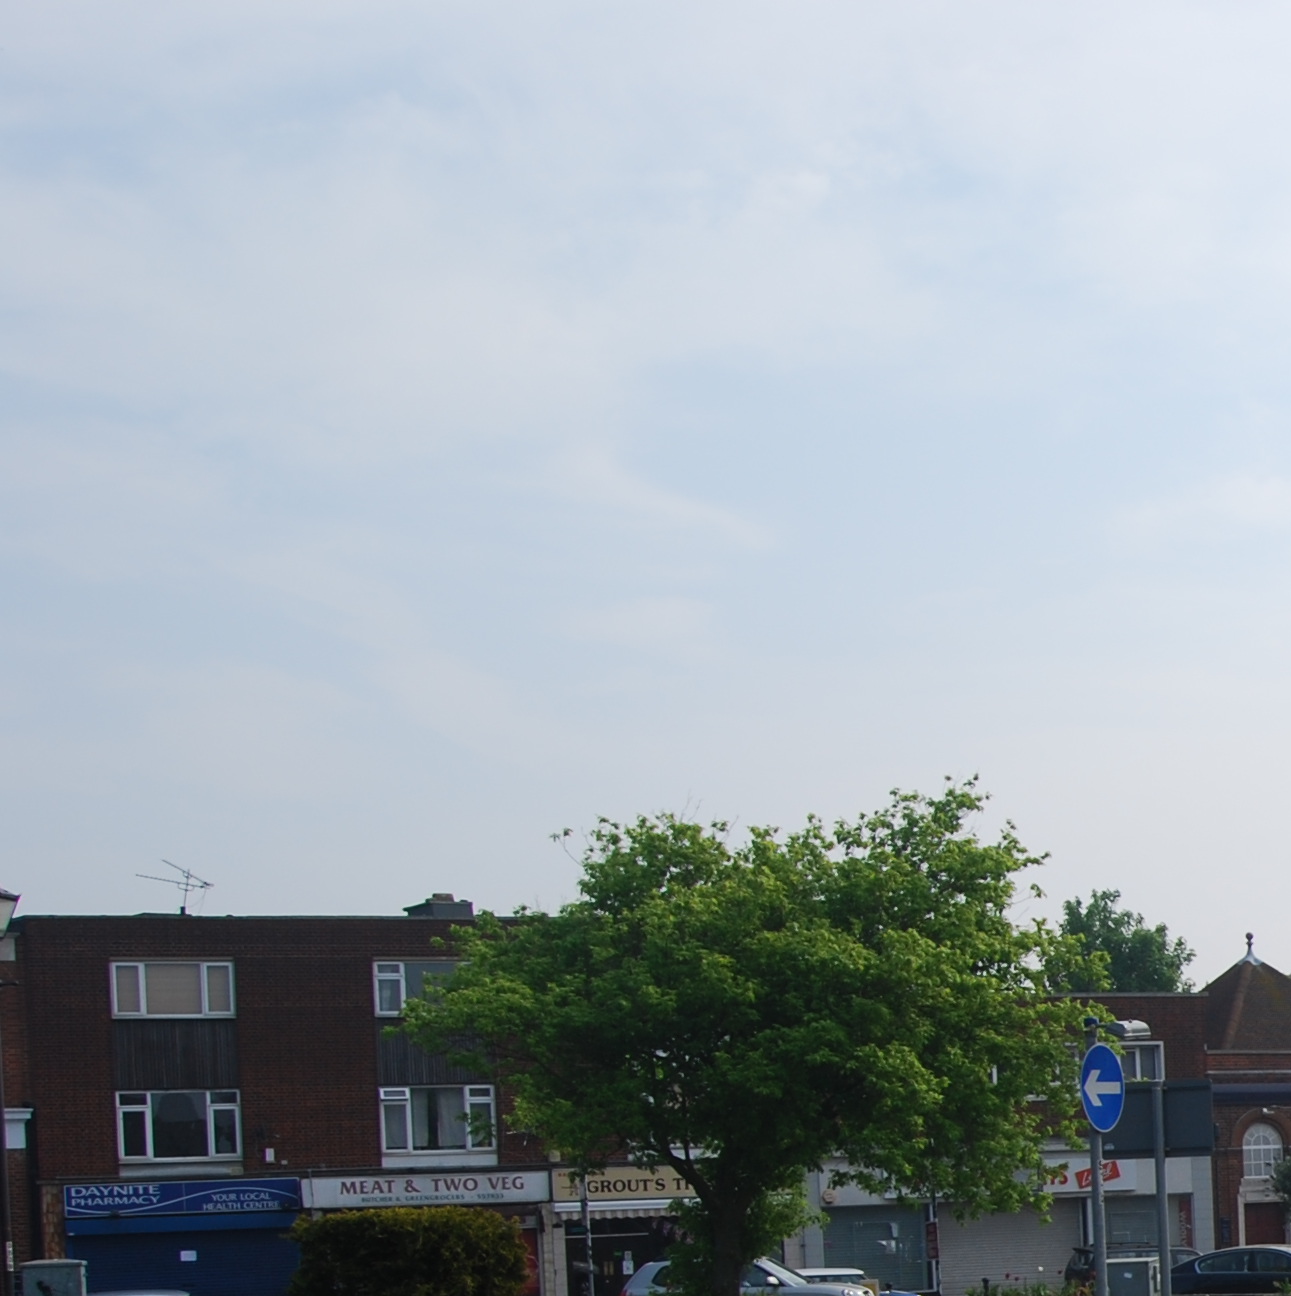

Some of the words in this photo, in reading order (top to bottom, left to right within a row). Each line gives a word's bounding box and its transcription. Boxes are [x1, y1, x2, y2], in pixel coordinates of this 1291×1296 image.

[71, 1184, 160, 1198] DAYNITE
[340, 1179, 396, 1195] MEAT
[404, 1178, 421, 1193] &
[431, 1177, 479, 1192] TWO
[487, 1175, 525, 1191] VEG
[587, 1177, 666, 1193] GROUT'S
[71, 1195, 160, 1207] PHARMACY
[211, 1193, 237, 1202] YOUR
[240, 1191, 271, 1200] LOCAL
[203, 1201, 241, 1211] HEALTH
[243, 1199, 280, 1210] CENTRE
